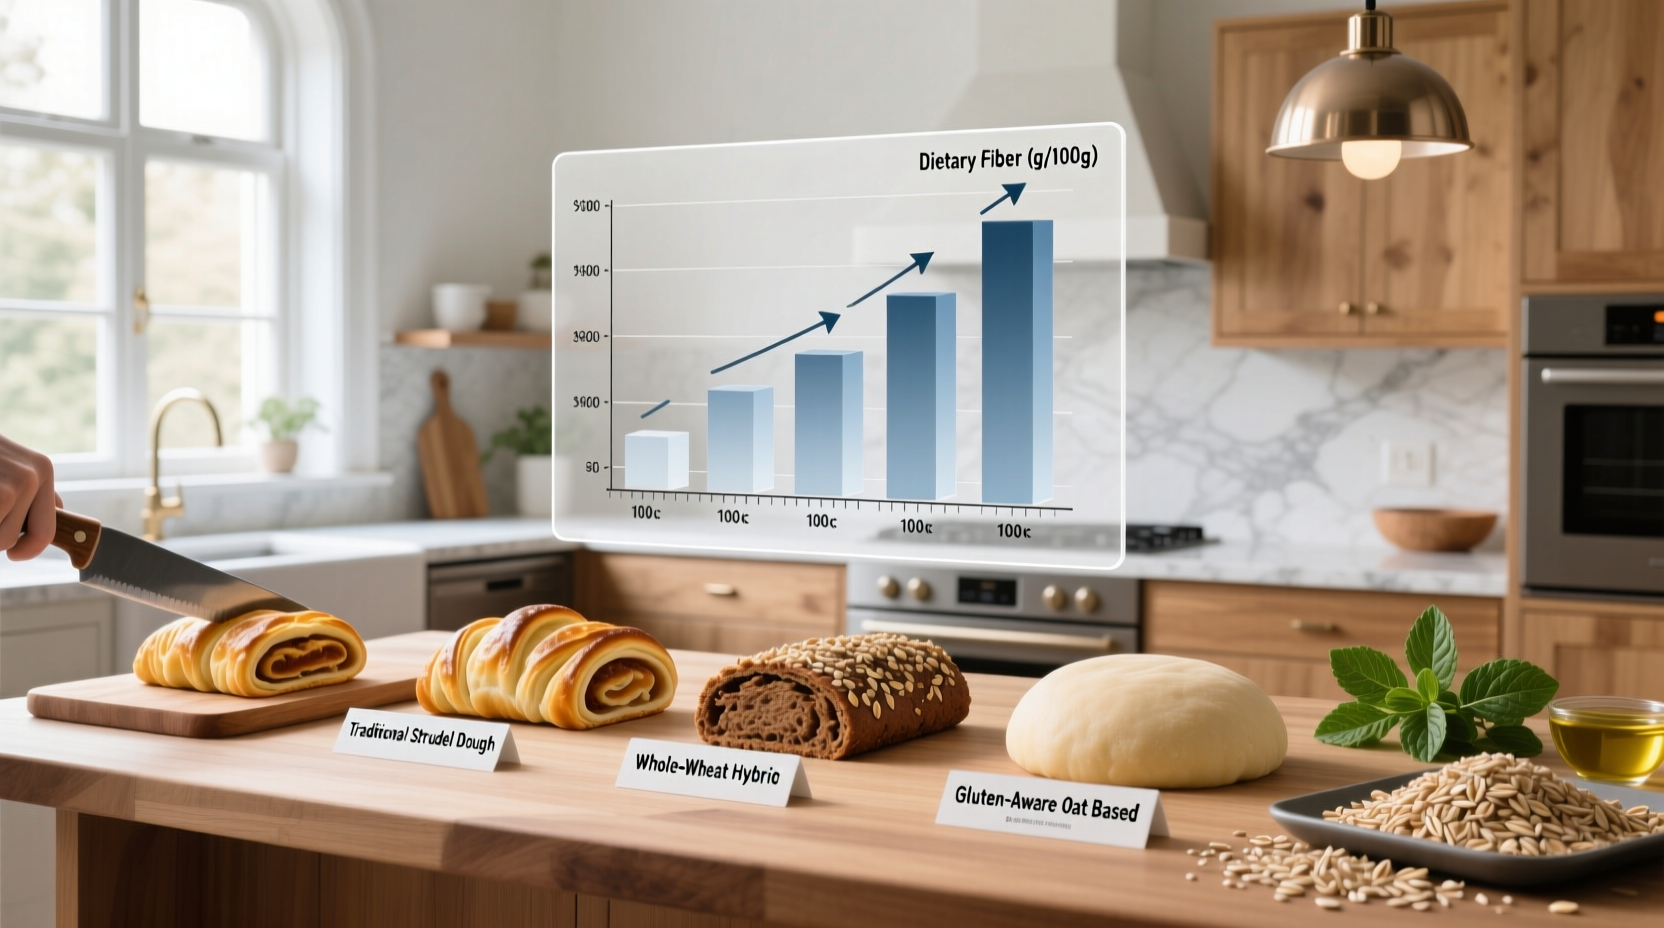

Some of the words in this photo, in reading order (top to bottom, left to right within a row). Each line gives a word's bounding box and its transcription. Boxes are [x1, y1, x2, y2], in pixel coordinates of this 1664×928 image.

[919, 152, 976, 173] Dietary
[981, 149, 1022, 168] Fiber
[1028, 144, 1098, 170] (g/100g)
[410, 728, 454, 747] Strudel
[456, 732, 495, 755] Dough
[636, 753, 729, 779] Whole-Wheat
[955, 785, 1057, 812] Gluten-Aware
[1062, 796, 1088, 816] Oat
[1091, 799, 1140, 822] Based
